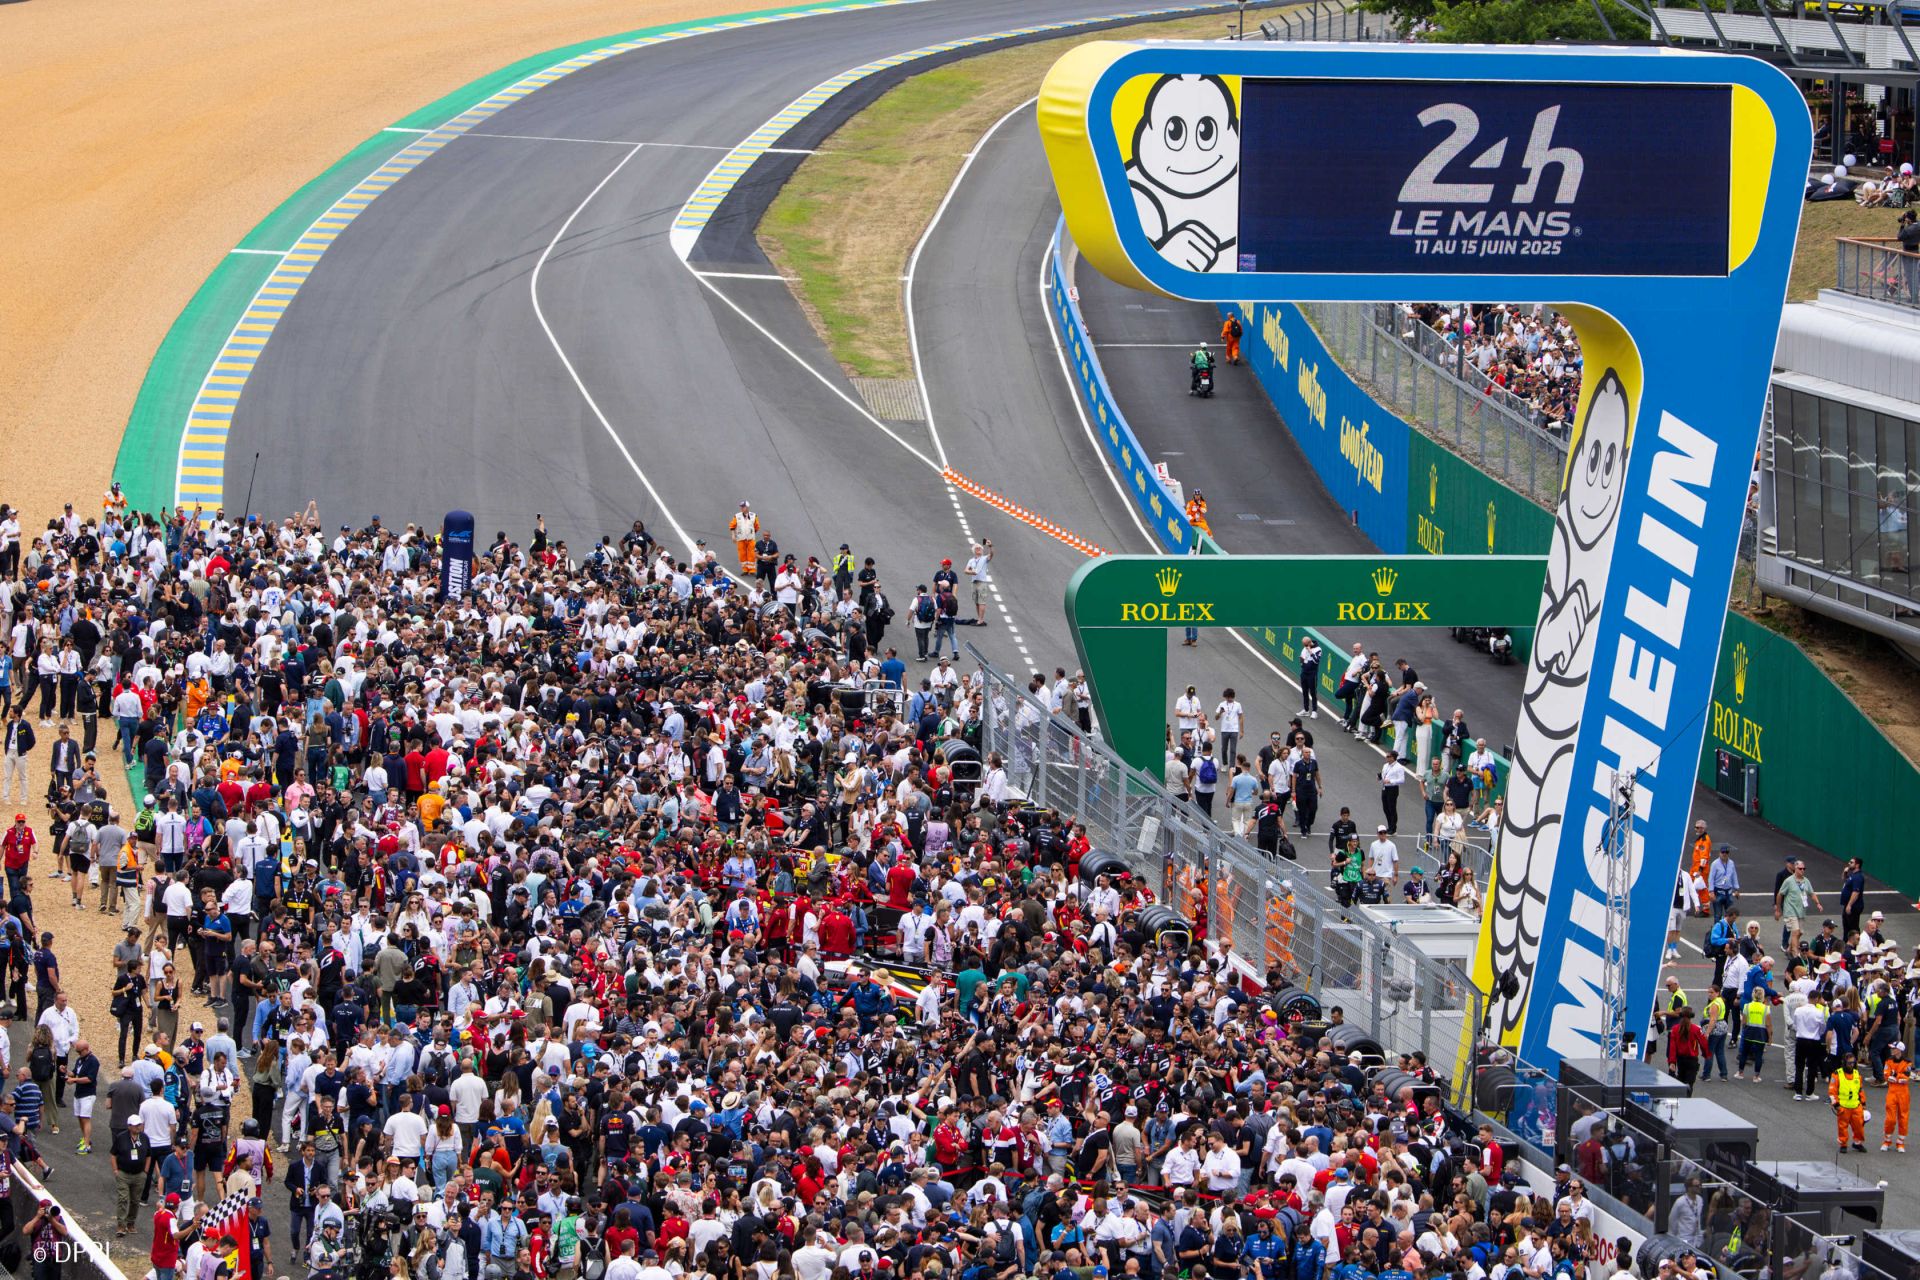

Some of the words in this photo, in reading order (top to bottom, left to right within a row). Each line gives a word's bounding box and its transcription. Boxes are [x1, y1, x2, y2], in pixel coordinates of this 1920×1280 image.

[1398, 102, 1585, 204] 24h
[1390, 210, 1443, 236] LE
[1415, 240, 1428, 255] 11
[1431, 240, 1457, 255] AU
[1461, 240, 1477, 255] 15
[1479, 240, 1517, 257] JUIN
[1520, 240, 1562, 255] 2025
[1340, 415, 1384, 494] GOODYEAR
[1121, 603, 1215, 621] ROLEX
[1337, 602, 1431, 621] ROLEX
[1547, 409, 1718, 1059] MICHELIN
[1713, 700, 1763, 763] ROLEX
[919, 970, 953, 979] CADAC
[1592, 1233, 1617, 1265] BOS
